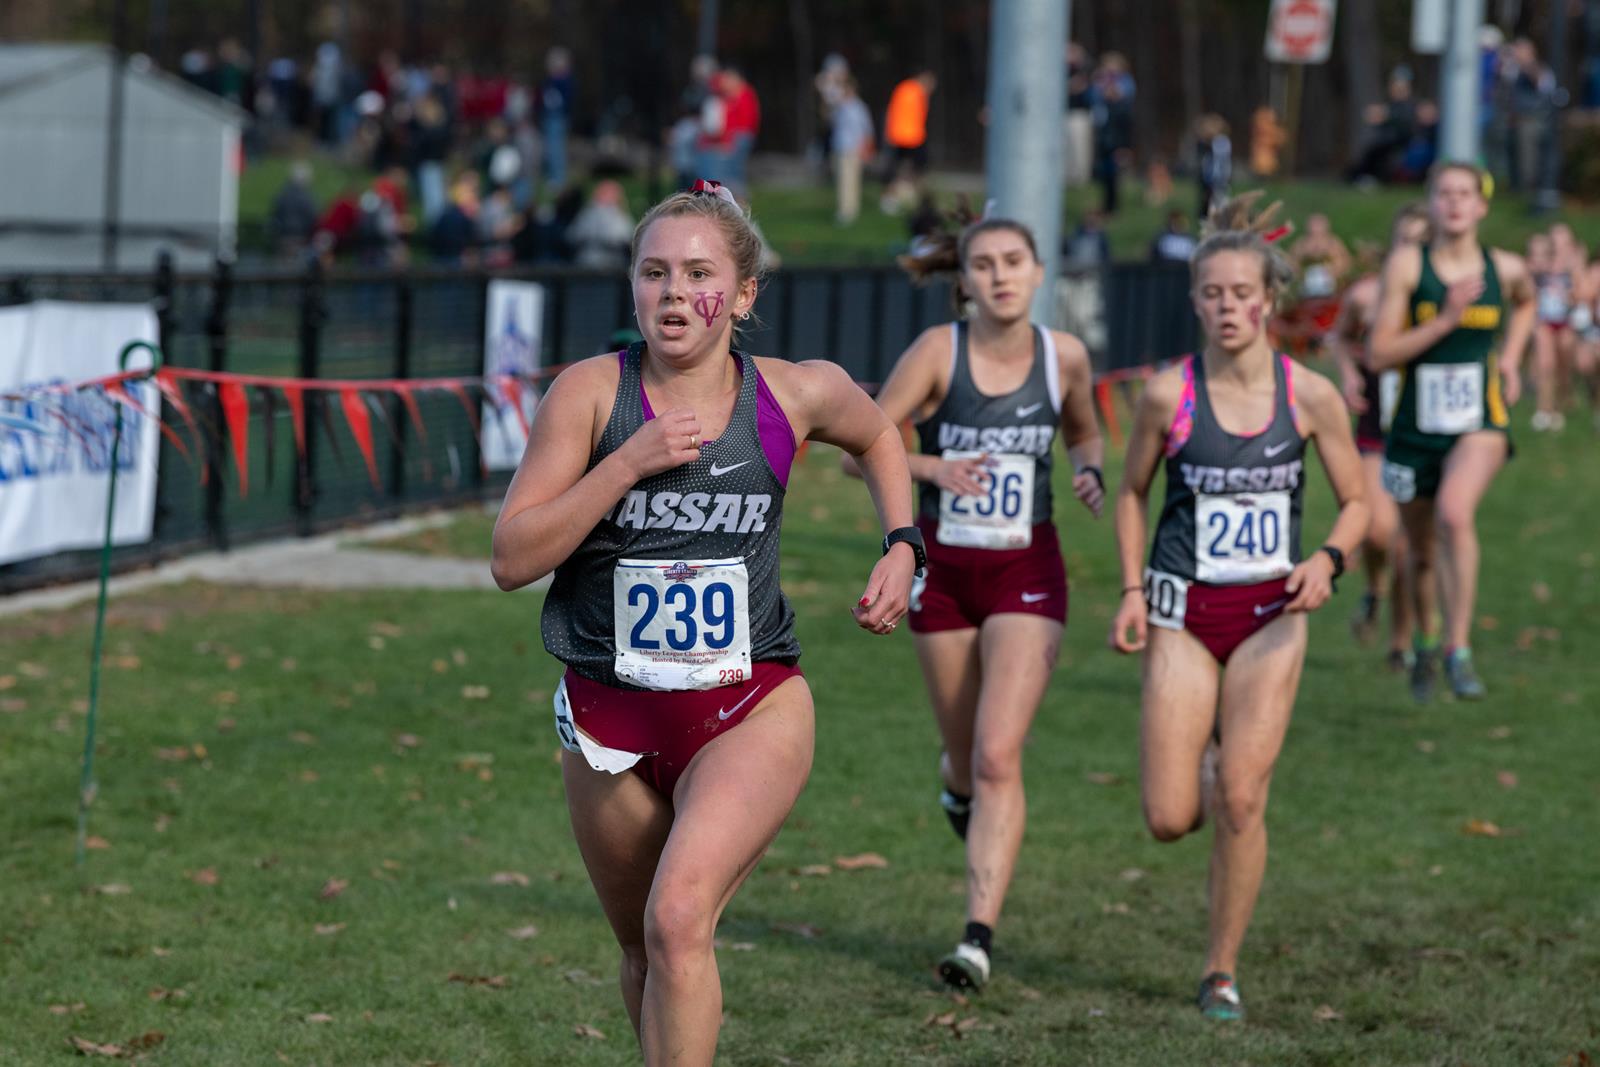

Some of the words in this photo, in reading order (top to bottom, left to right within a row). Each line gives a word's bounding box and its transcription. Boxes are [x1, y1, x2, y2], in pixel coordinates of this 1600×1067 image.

[938, 423, 1055, 456] VASSAR
[604, 489, 772, 533] ASSAR
[1208, 508, 1280, 557] 240
[628, 583, 735, 650] 239
[684, 649, 729, 657] Championship
[719, 668, 744, 685] 239
